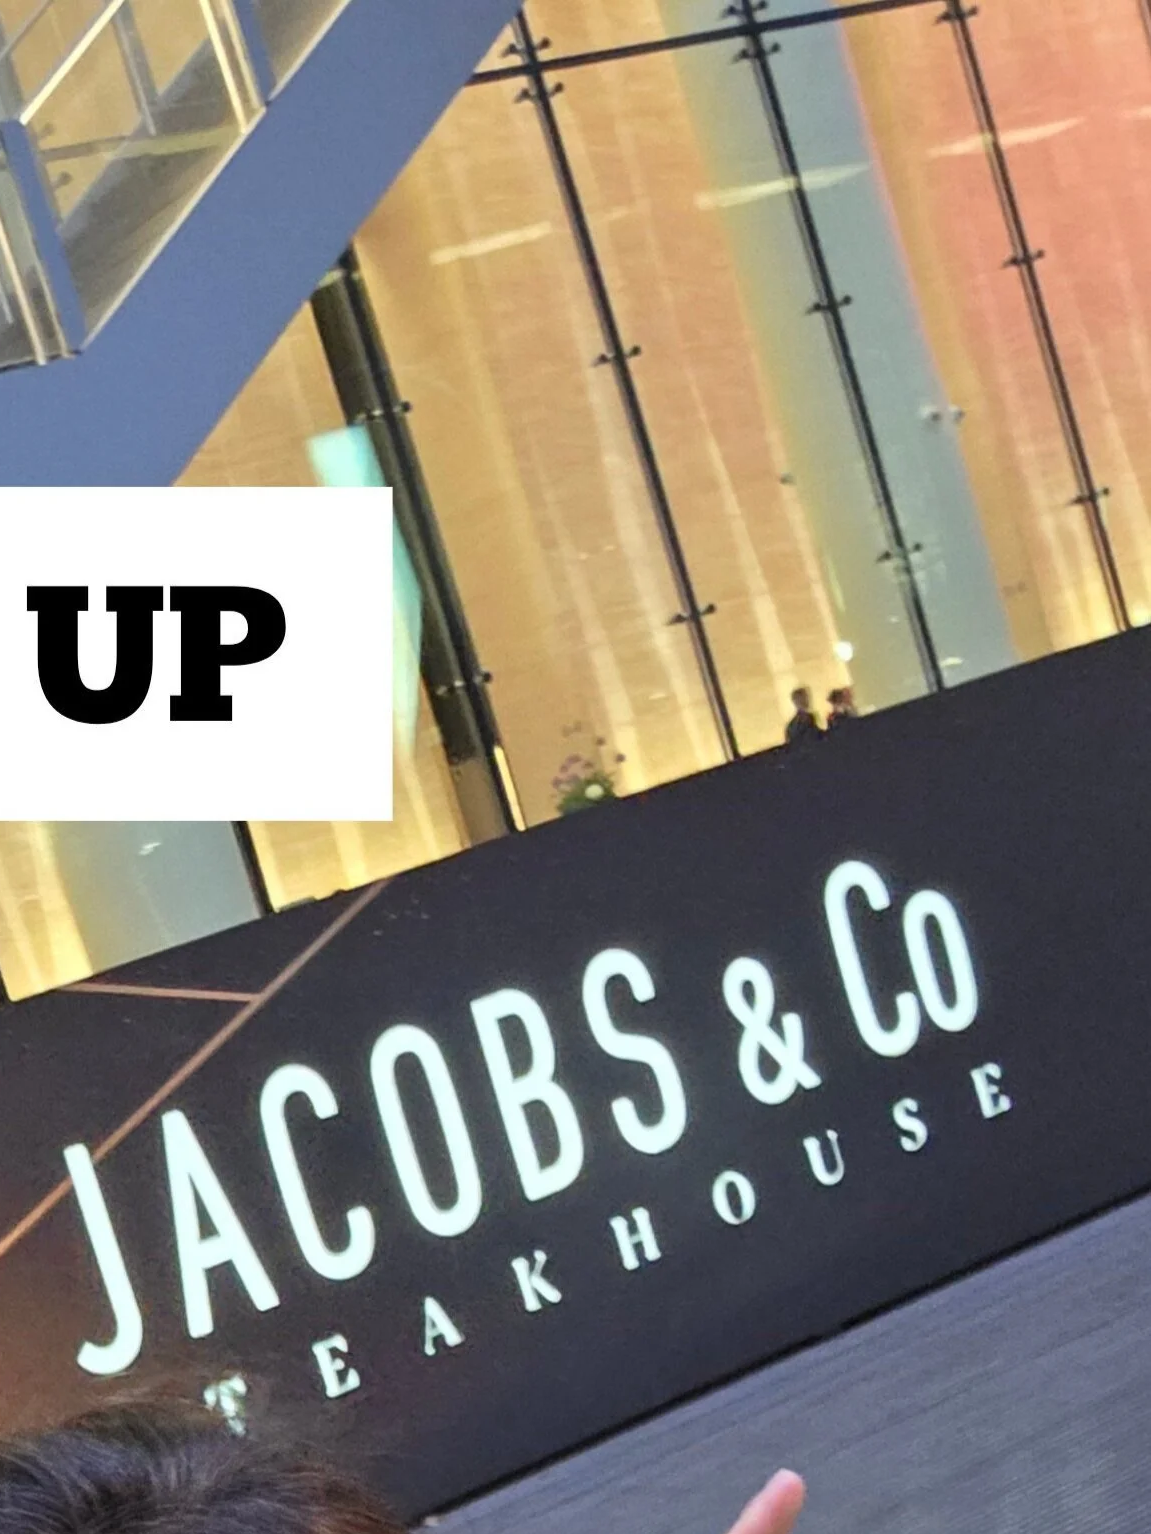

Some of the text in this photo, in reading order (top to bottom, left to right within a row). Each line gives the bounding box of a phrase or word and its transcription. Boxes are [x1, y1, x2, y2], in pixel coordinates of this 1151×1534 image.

[64, 860, 978, 1375] JACOBS & Co
[203, 1063, 1012, 1434] TEAKHOUSE
